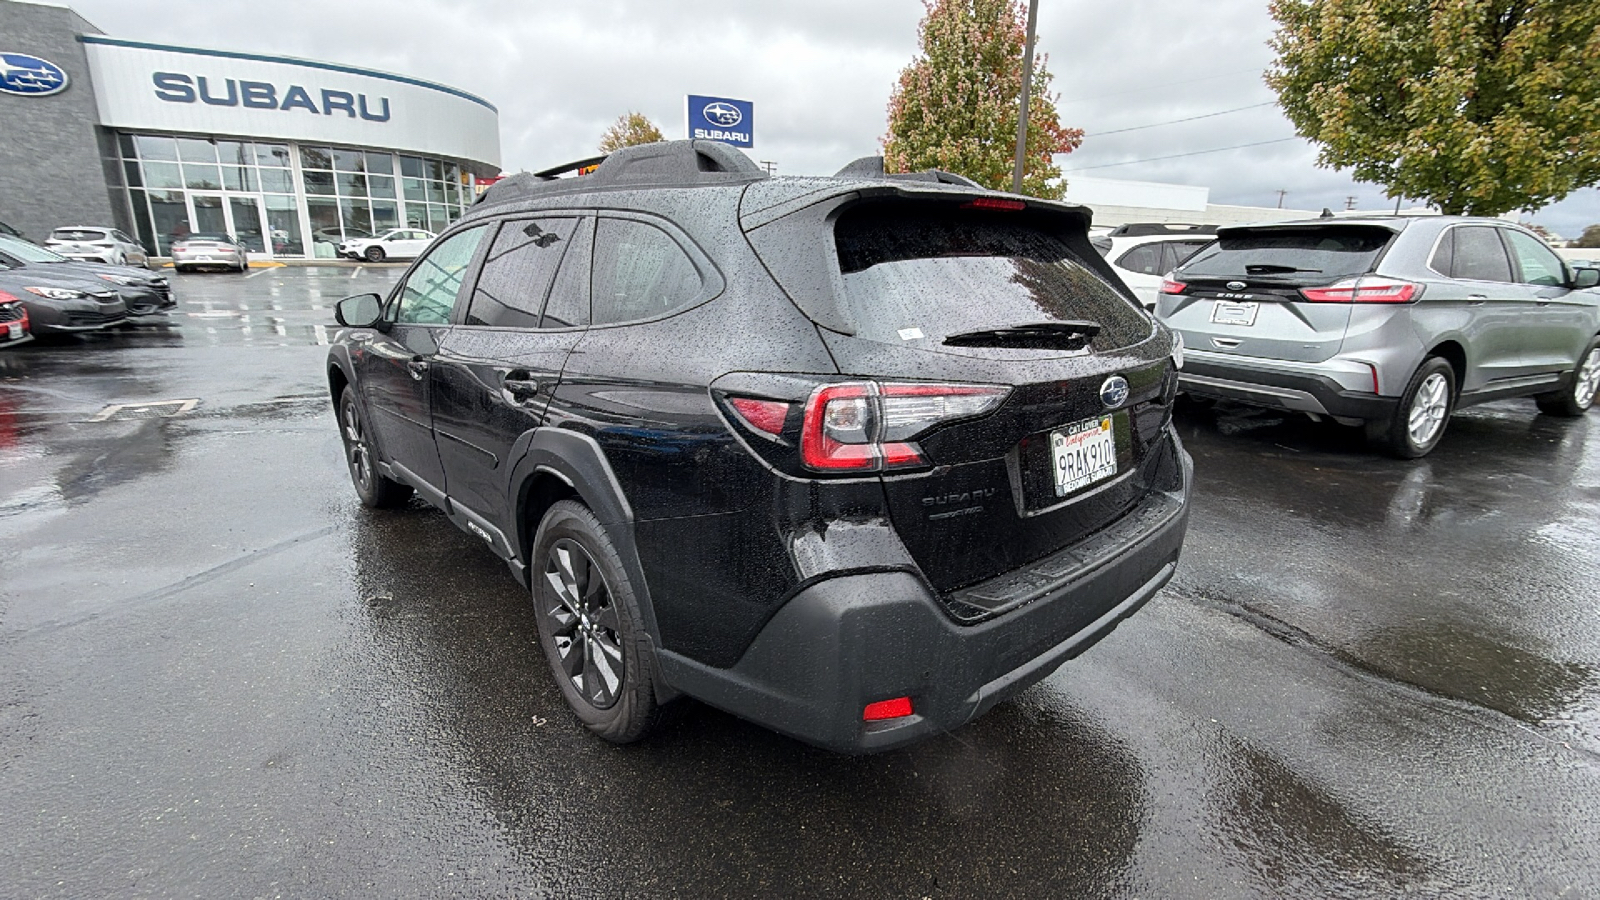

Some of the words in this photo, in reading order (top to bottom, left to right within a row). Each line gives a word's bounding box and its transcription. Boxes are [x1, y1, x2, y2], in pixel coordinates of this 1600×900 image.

[153, 71, 391, 122] SUBARU
[694, 128, 749, 142] SUBARU
[1068, 424, 1081, 435] CAT
[1059, 439, 1111, 483] 9RAK910
[922, 488, 995, 506] SUBARU
